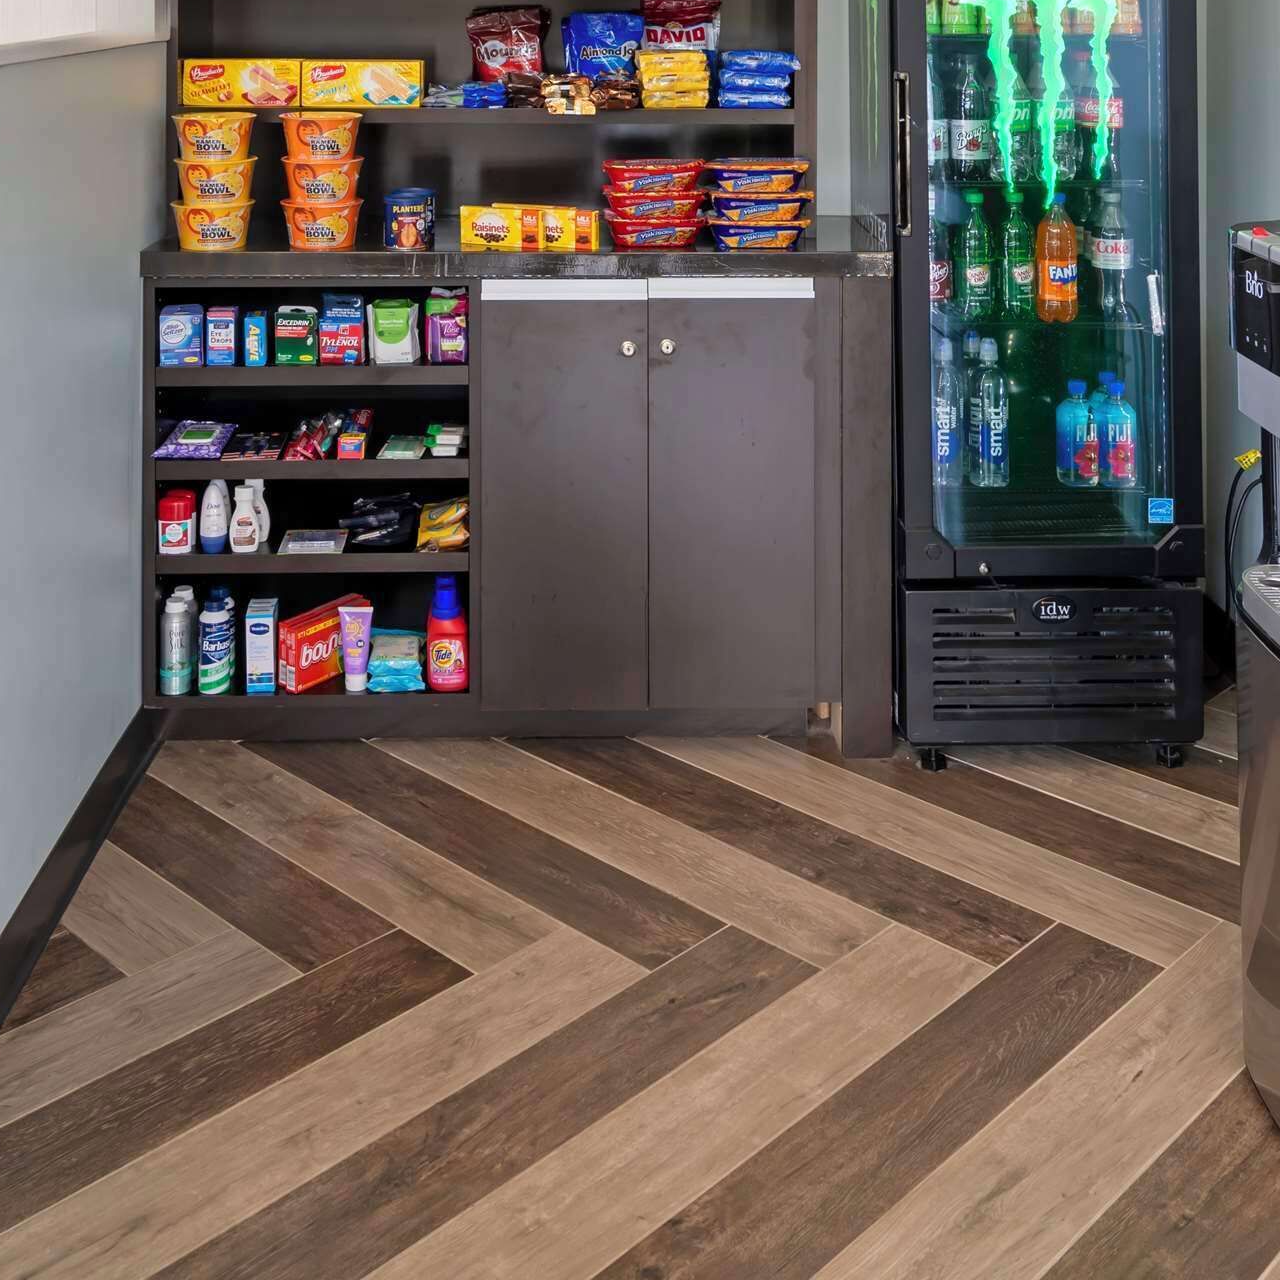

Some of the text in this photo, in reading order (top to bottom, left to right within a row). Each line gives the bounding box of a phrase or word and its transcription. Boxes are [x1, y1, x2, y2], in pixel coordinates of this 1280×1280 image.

[646, 26, 705, 44] DAVID
[476, 44, 537, 62] Mounds
[580, 46, 622, 60] Almond
[392, 205, 424, 213] PLANTERS
[201, 231, 232, 239] BOWL
[471, 222, 511, 233] Raisinets
[1096, 240, 1128, 255] Coke
[1048, 264, 1078, 280] FANT
[1245, 270, 1264, 299] Brio
[277, 318, 310, 326] EXCEDRIN
[320, 337, 359, 346] TYLENOL
[936, 406, 950, 456] smart
[989, 406, 1003, 456] smart
[1076, 424, 1098, 441] FIJI
[1108, 424, 1131, 441] FIJI
[1040, 601, 1071, 616] idw
[434, 649, 452, 662] Tide
